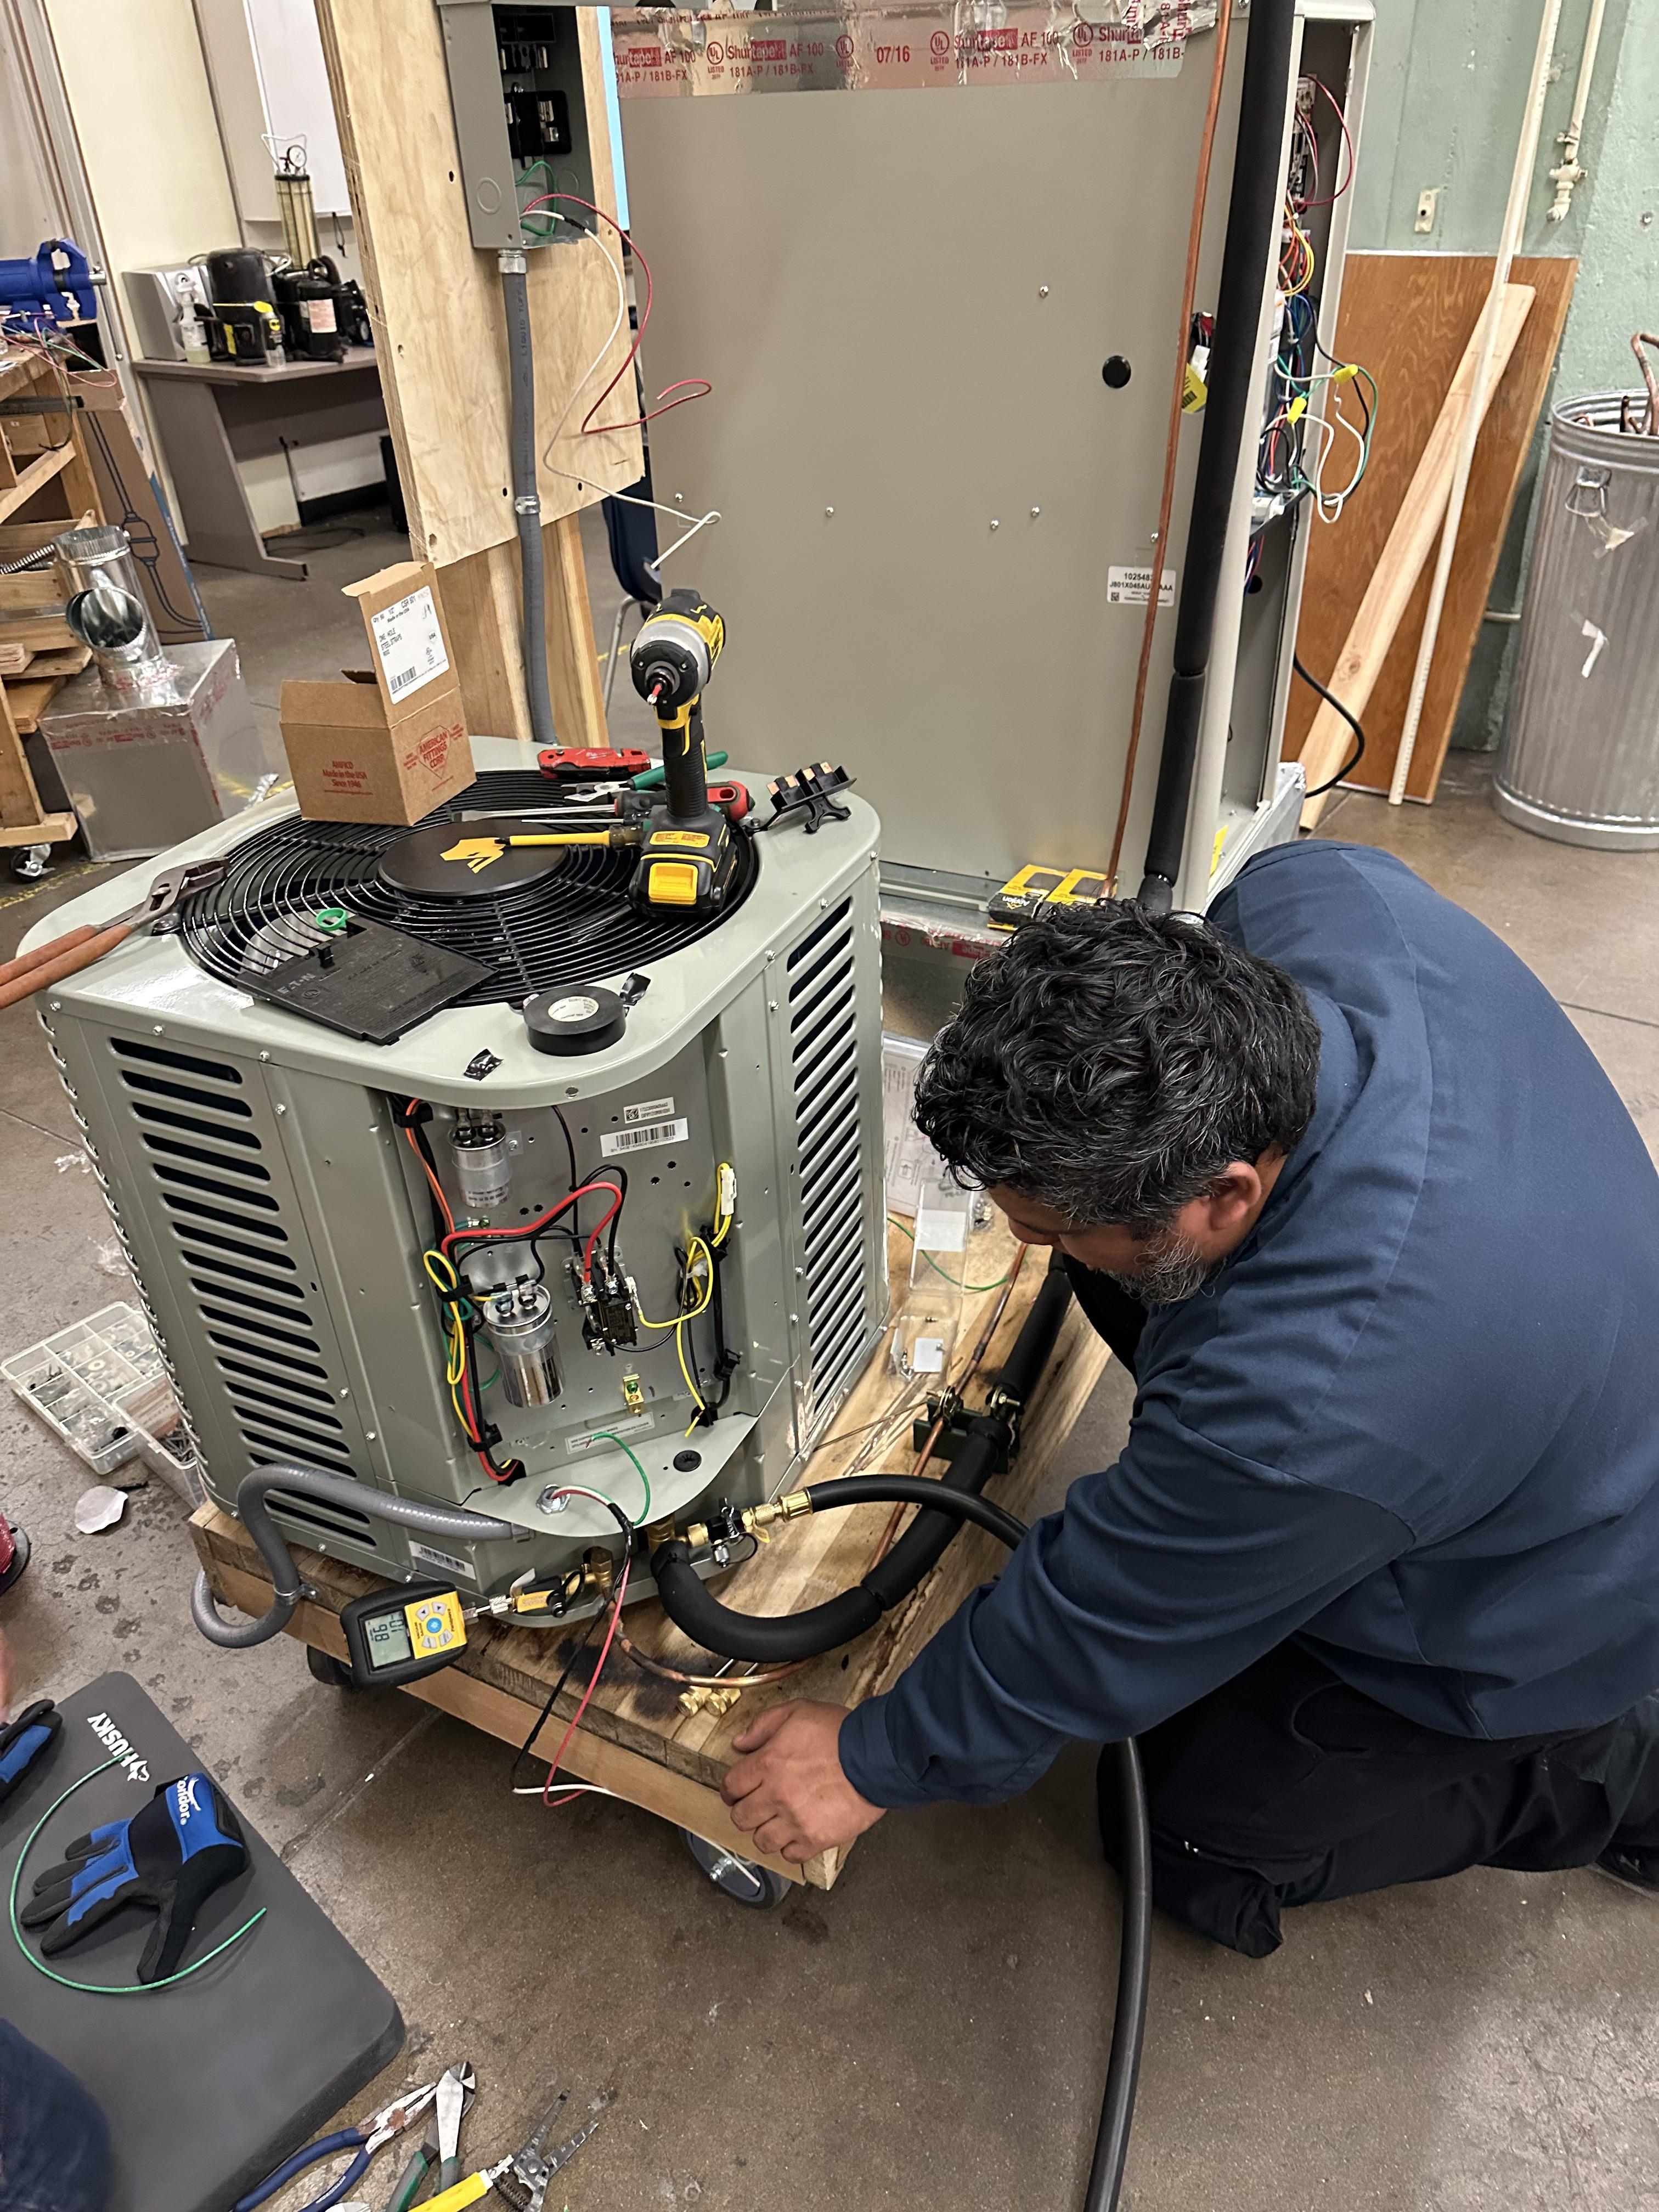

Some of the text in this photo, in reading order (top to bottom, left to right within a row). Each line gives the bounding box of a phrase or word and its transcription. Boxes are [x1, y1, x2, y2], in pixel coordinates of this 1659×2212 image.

[1020, 32, 1037, 48] AF
[1042, 31, 1059, 46] 100
[664, 51, 676, 63] AF
[681, 49, 696, 63] 100
[727, 40, 824, 61] Shurtape AF 100
[877, 45, 910, 63] 07/16
[1099, 49, 1140, 62] 181A-P
[930, 57, 949, 65] LISTED
[956, 56, 990, 69] 181A-P
[1002, 52, 1047, 66] 181B-FX
[650, 69, 688, 81] 181B-FX
[730, 65, 763, 78] 181A-P
[774, 63, 815, 76] 181B-FX
[1124, 573, 1153, 581] 102548
[86, 1712, 139, 1768] HUSKY
[177, 1776, 190, 1820] ondor
